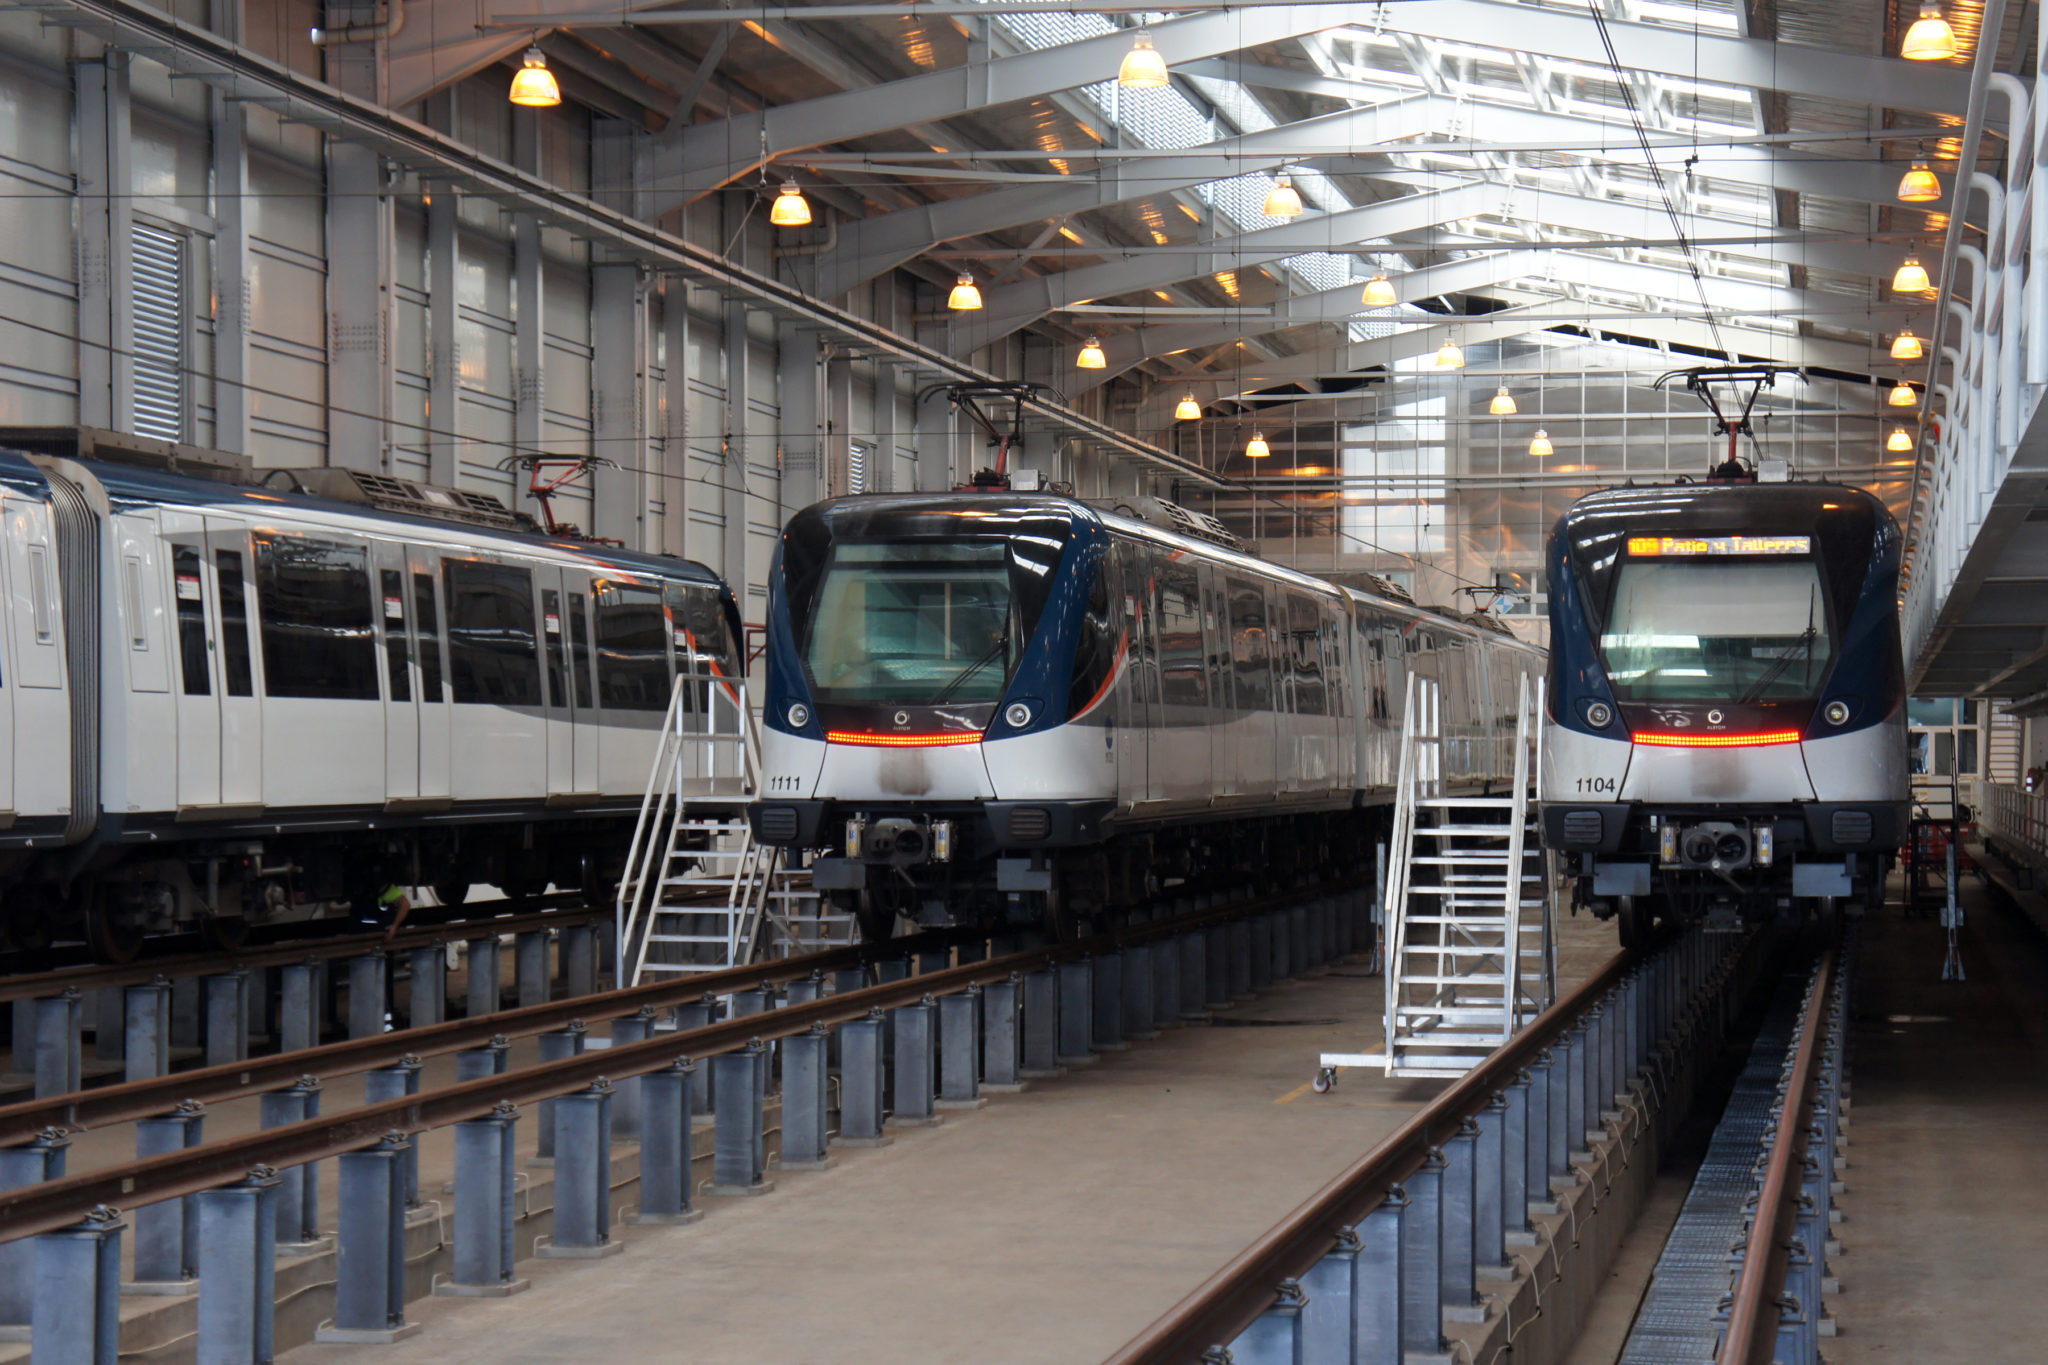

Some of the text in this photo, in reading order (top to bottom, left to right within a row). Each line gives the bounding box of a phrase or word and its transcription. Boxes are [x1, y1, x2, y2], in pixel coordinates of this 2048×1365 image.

[1661, 537, 1708, 552] Patio
[1731, 536, 1808, 551] Talleres
[771, 776, 800, 791] 1111
[1576, 777, 1616, 793] 1104
